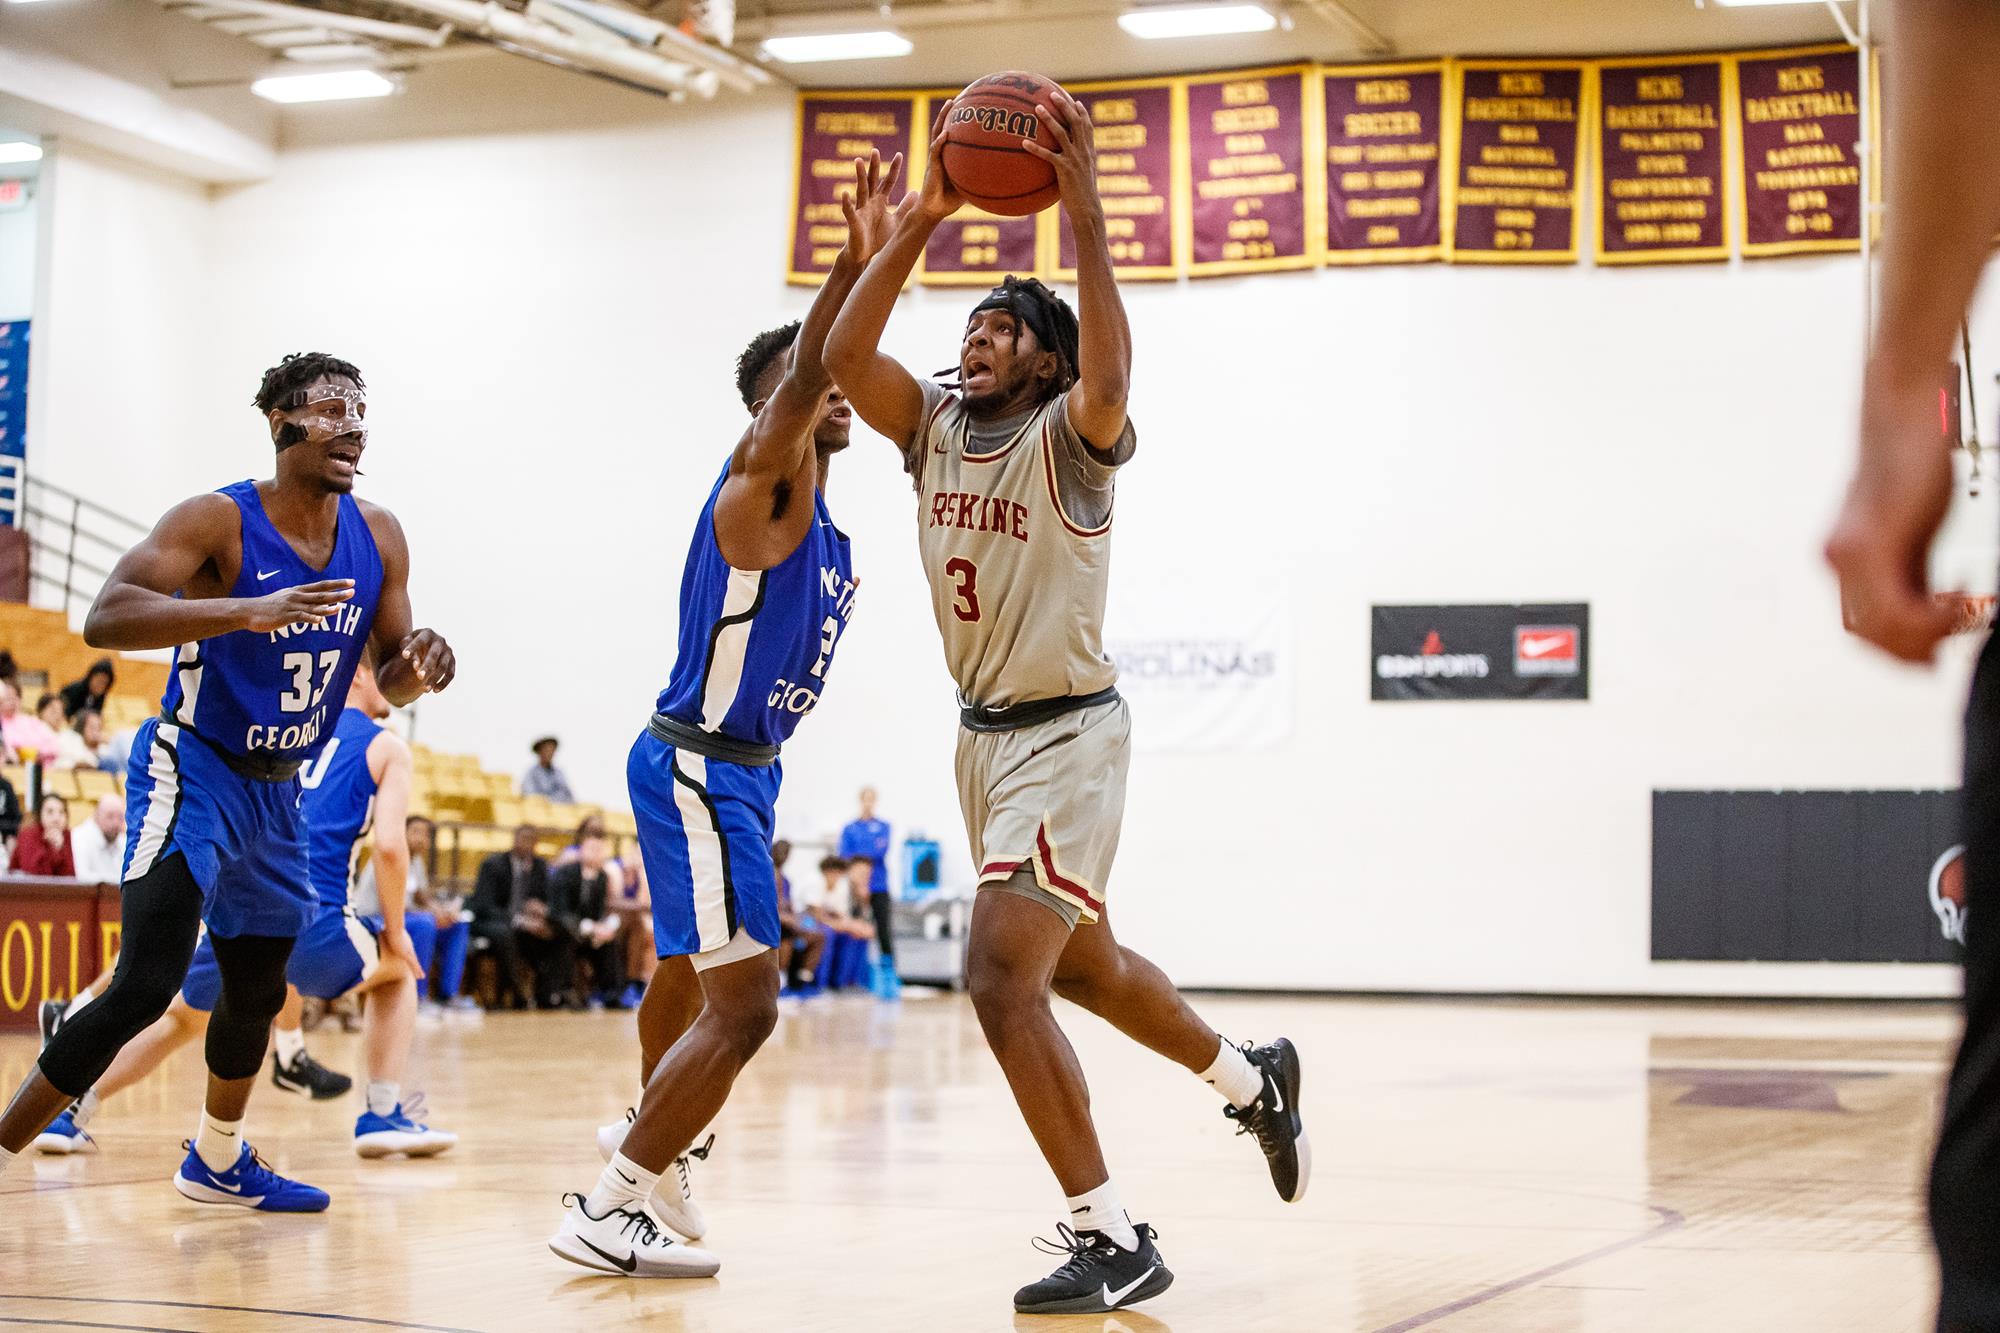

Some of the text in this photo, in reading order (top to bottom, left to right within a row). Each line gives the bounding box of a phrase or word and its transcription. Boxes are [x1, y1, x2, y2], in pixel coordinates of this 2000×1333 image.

[951, 105, 1038, 140] Wilson
[1746, 91, 1858, 123] BASKETBALL
[930, 492, 1029, 543] RSKINE
[820, 566, 855, 622] NOTH
[945, 556, 981, 624] 3
[281, 650, 341, 713] 33
[247, 705, 326, 751] GEORGI
